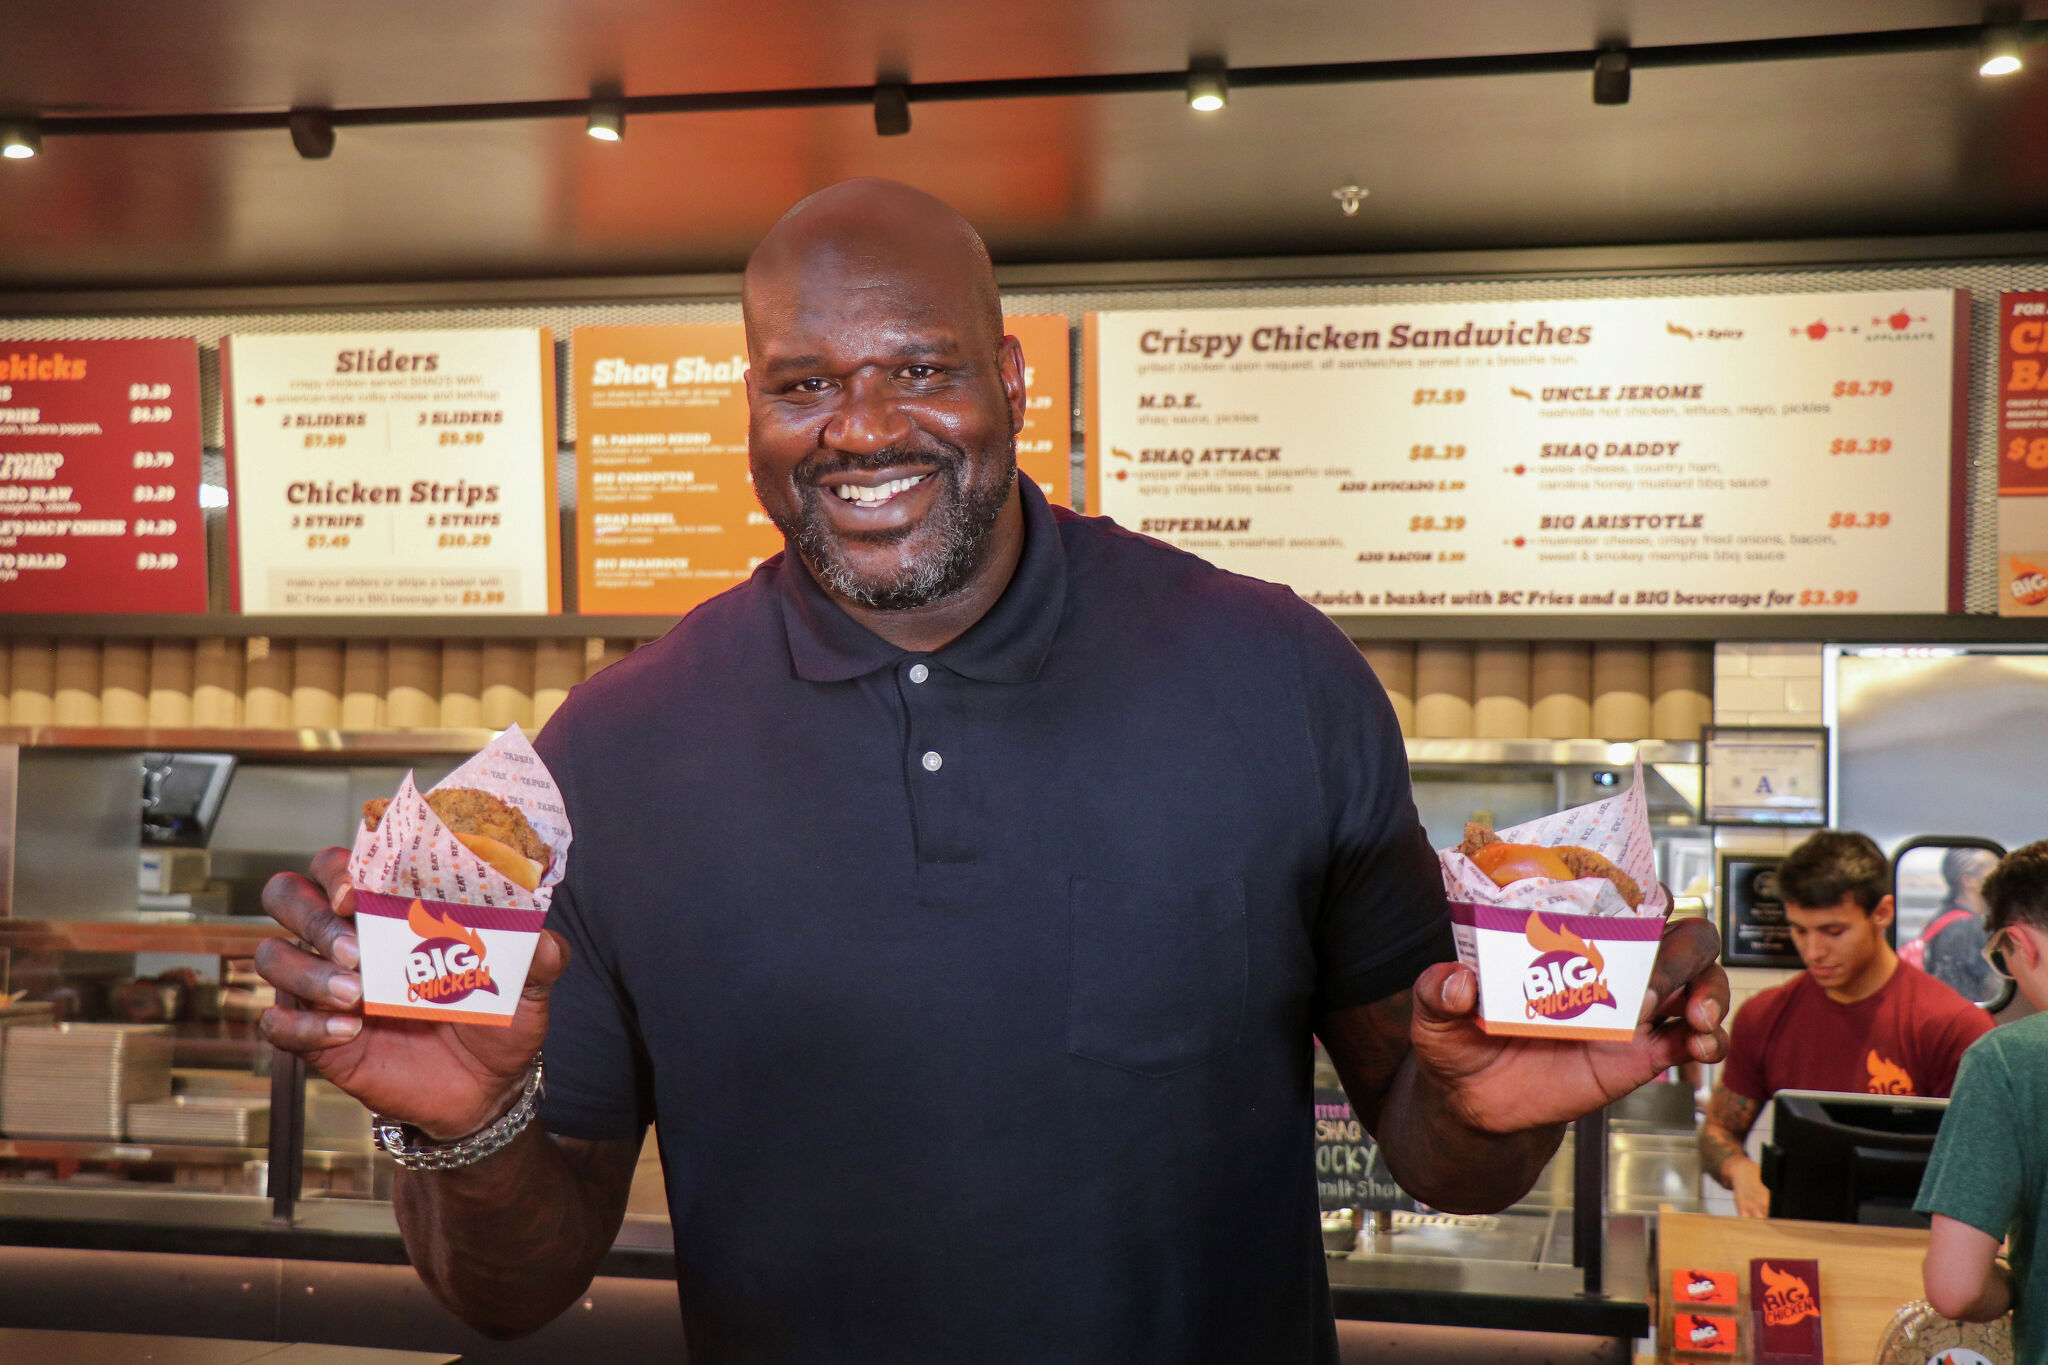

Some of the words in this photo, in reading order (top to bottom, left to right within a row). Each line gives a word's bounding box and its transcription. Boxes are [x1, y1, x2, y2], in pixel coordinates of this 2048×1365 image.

[2012, 302, 2047, 317] FOR
[1139, 328, 1243, 359] Crispy
[1250, 325, 1380, 352] Chicken
[1387, 320, 1593, 348] Sandwiches
[336, 348, 440, 373] Sliders
[592, 356, 670, 389] Shaq
[1541, 386, 1611, 402] UNCLE
[1616, 383, 1704, 401] JEROME
[1831, 379, 1894, 398] $8.79
[1138, 392, 1202, 410] M.D.E.
[295, 412, 367, 427] SLIDERS
[431, 410, 503, 425] SLIDERS
[1139, 446, 1195, 466] SHAQ
[1199, 445, 1283, 463] ATTACK
[1540, 442, 1599, 461] SHAQ
[1603, 441, 1681, 458] DADDY
[1828, 437, 1893, 456] $8.39
[286, 480, 401, 505] Chicken
[409, 479, 501, 508] Strips
[304, 514, 365, 528] STRIPS
[440, 513, 501, 527] STRIPS
[1140, 517, 1252, 533] SUPERMAN
[1539, 514, 1577, 530] BIG
[1580, 512, 1705, 530] ARISTOTLE
[1827, 510, 1892, 530] $8.39
[1744, 551, 1786, 562] sauce
[2011, 573, 2048, 598] BIG
[1369, 594, 1381, 606] a
[1384, 590, 1447, 605] basket
[1451, 590, 1493, 605] with
[1497, 591, 1524, 605] BC
[1528, 590, 1574, 605] Fries
[1579, 590, 1615, 605] and
[1619, 594, 1630, 605] a
[1635, 591, 1670, 605] BIG
[1674, 590, 1762, 607] beverage
[1766, 588, 1796, 607] for
[1799, 589, 1859, 606] $3.99
[1755, 775, 1774, 795] A
[455, 873, 467, 893] EAT
[406, 943, 480, 985] BIG
[407, 965, 491, 1003] CHICKEN
[1524, 956, 1598, 1000] BIG
[1525, 978, 1610, 1020] CHICKEN
[1315, 1119, 1363, 1143] SHAQ
[1765, 1286, 1806, 1311] BIG
[1766, 1296, 1814, 1325] CHICKEN
